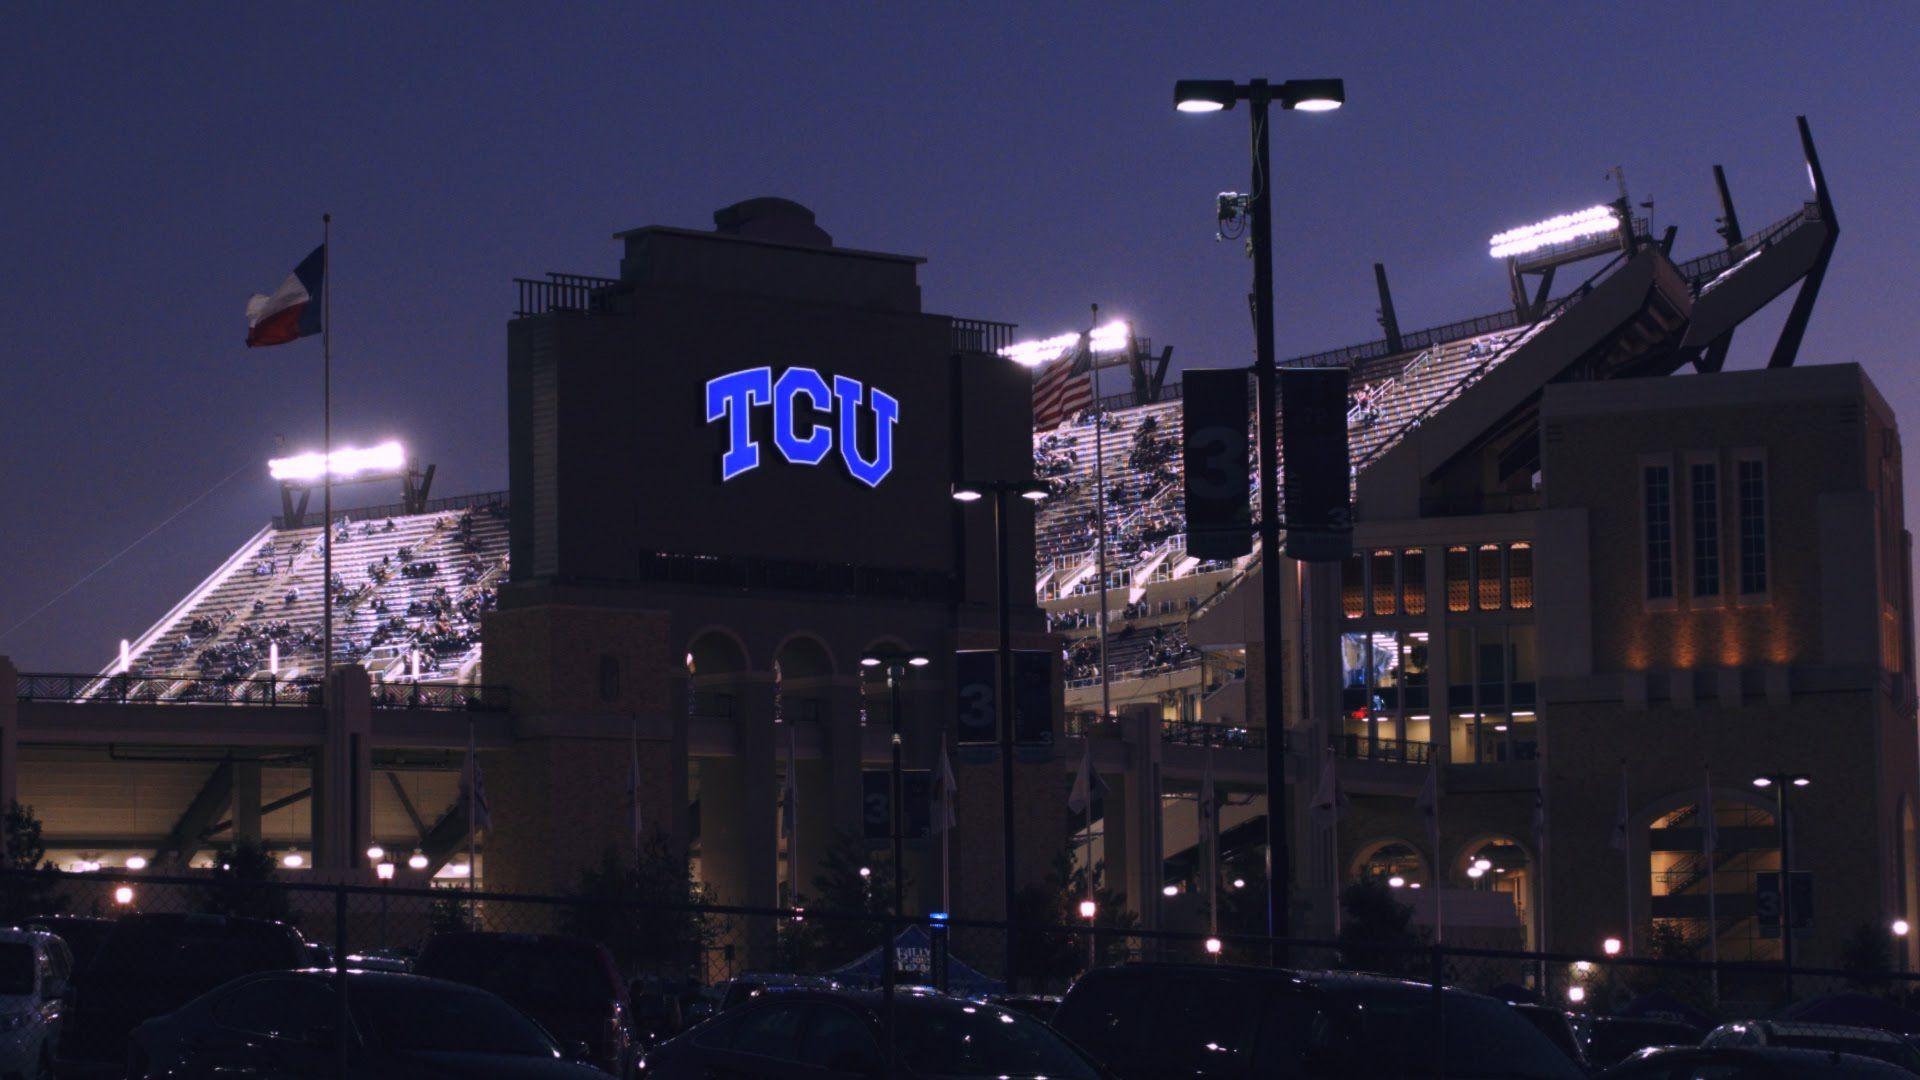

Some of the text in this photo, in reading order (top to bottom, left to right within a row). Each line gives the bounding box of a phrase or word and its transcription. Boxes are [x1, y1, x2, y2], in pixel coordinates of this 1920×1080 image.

[706, 366, 898, 488] TCU
[1188, 425, 1245, 498] 3
[960, 683, 995, 727] 3
[1040, 730, 1052, 743] 3
[865, 793, 889, 824] 3
[1759, 891, 1778, 917] 3
